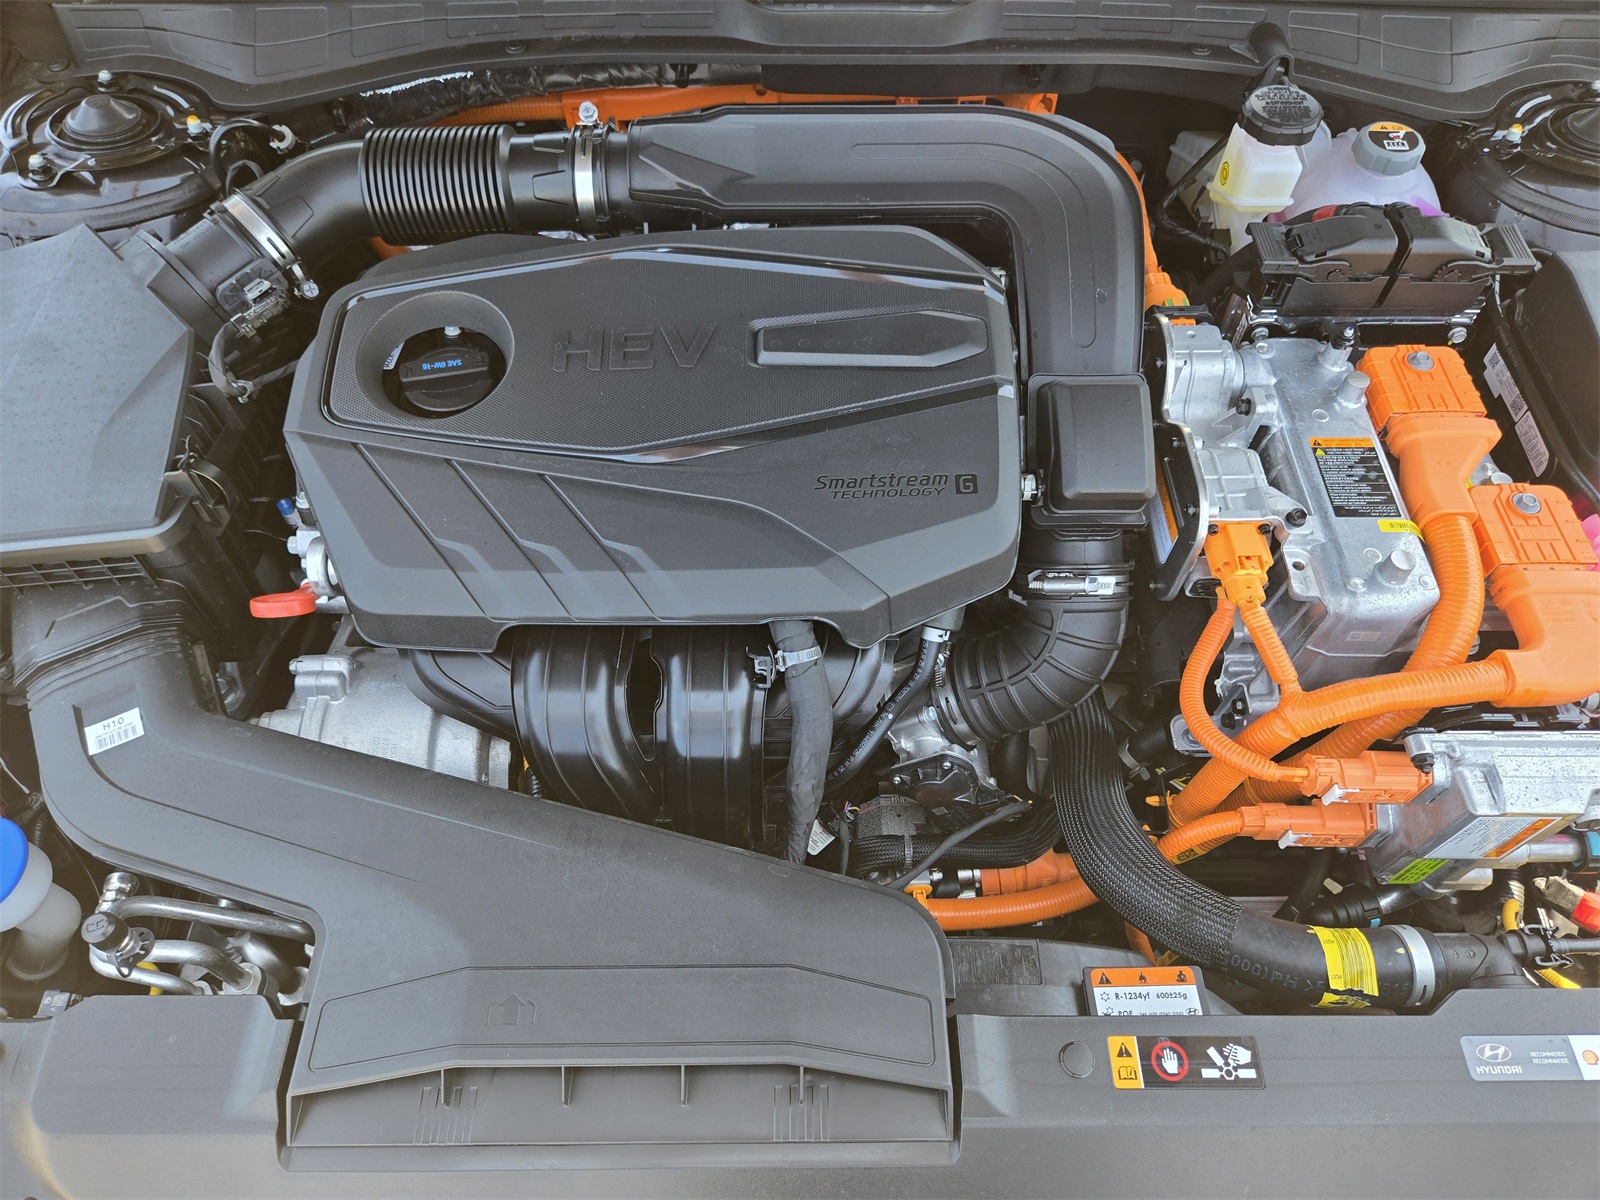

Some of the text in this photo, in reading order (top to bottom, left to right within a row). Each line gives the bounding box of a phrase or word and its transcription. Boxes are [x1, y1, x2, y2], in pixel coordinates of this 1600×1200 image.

[552, 322, 718, 373] HEV
[422, 359, 462, 371] SAE 0W-16
[814, 472, 976, 493] Smartstream G
[831, 487, 945, 500] TECHNOLOGY
[102, 717, 125, 731] H10
[1114, 991, 1188, 1001] R-1234yf 600±25g
[1475, 1065, 1523, 1074] HYUNDAI
